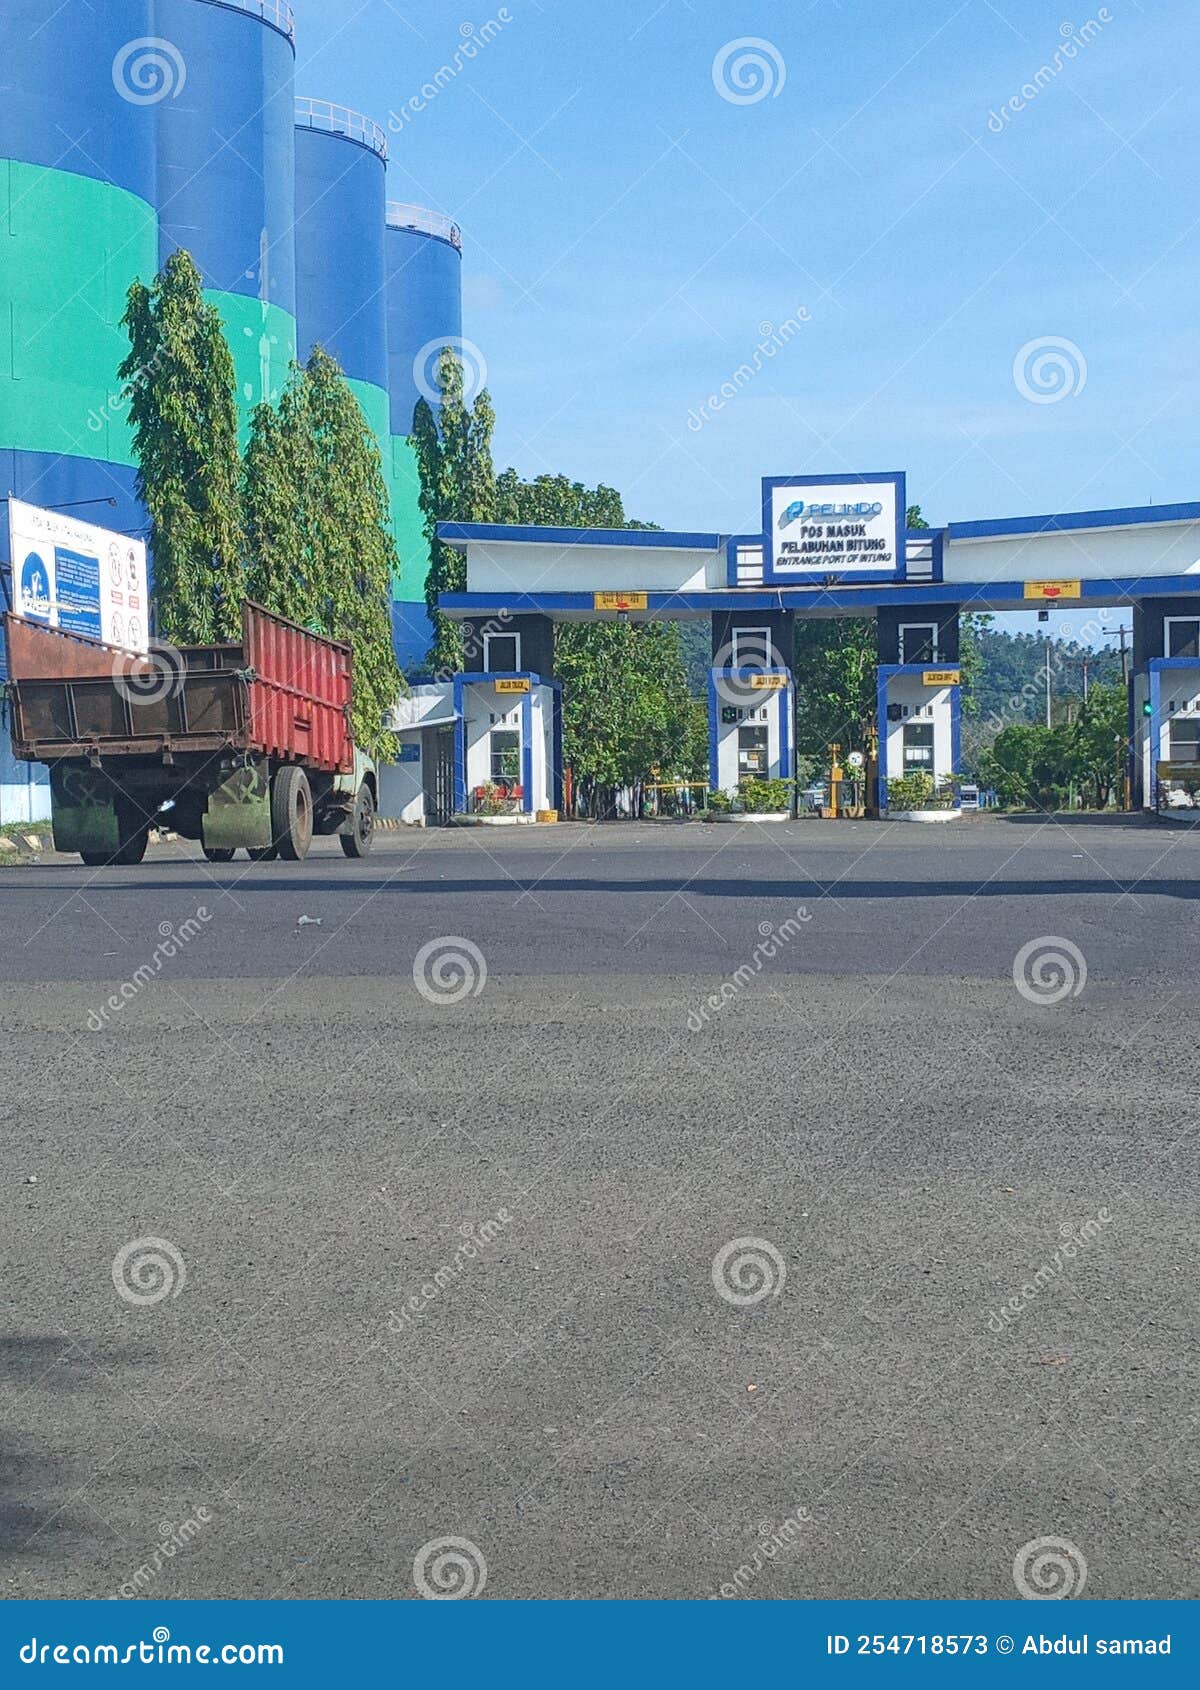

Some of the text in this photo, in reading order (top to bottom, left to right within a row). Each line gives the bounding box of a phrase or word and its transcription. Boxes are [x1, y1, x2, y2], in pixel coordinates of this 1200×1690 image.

[809, 502, 883, 516] PELINDO
[801, 524, 867, 539] POS MASUK
[781, 538, 886, 554] PELABUHAN BITUNG
[776, 555, 822, 566] ENTRANCE
[822, 554, 846, 565] PORT
[847, 553, 860, 564] OF
